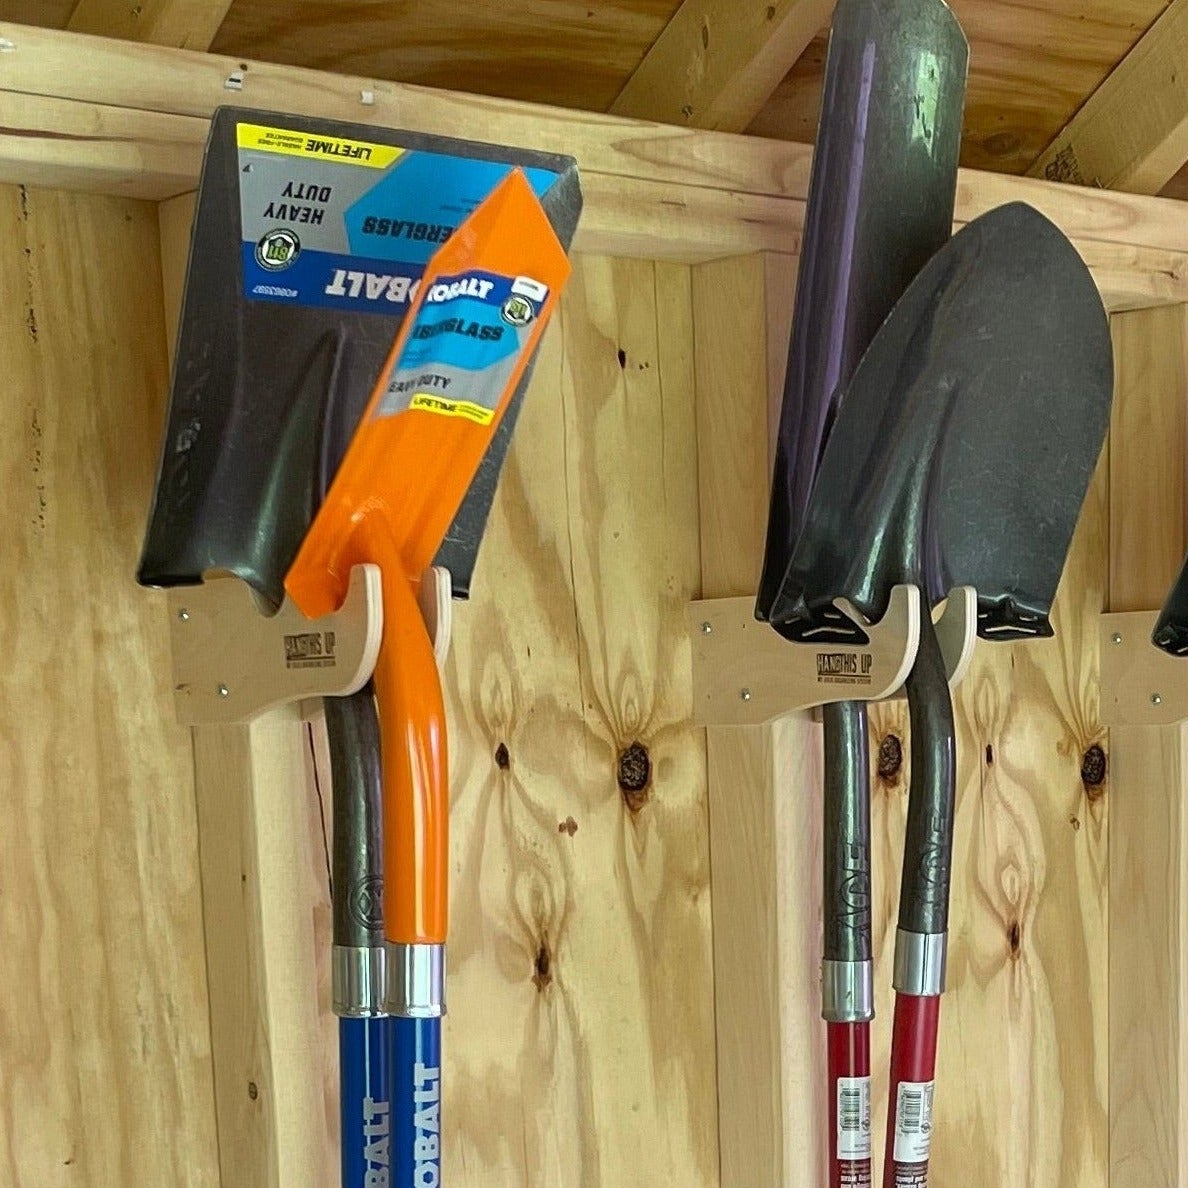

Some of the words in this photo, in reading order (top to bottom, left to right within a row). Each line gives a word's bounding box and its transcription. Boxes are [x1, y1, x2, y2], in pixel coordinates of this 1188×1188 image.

[305, 138, 372, 161] LIFETIME
[281, 180, 332, 203] DUTY
[263, 202, 325, 225] HEAVY
[361, 215, 456, 245] ERGLASS
[324, 269, 422, 303] BALT
[861, 653, 872, 674] UP
